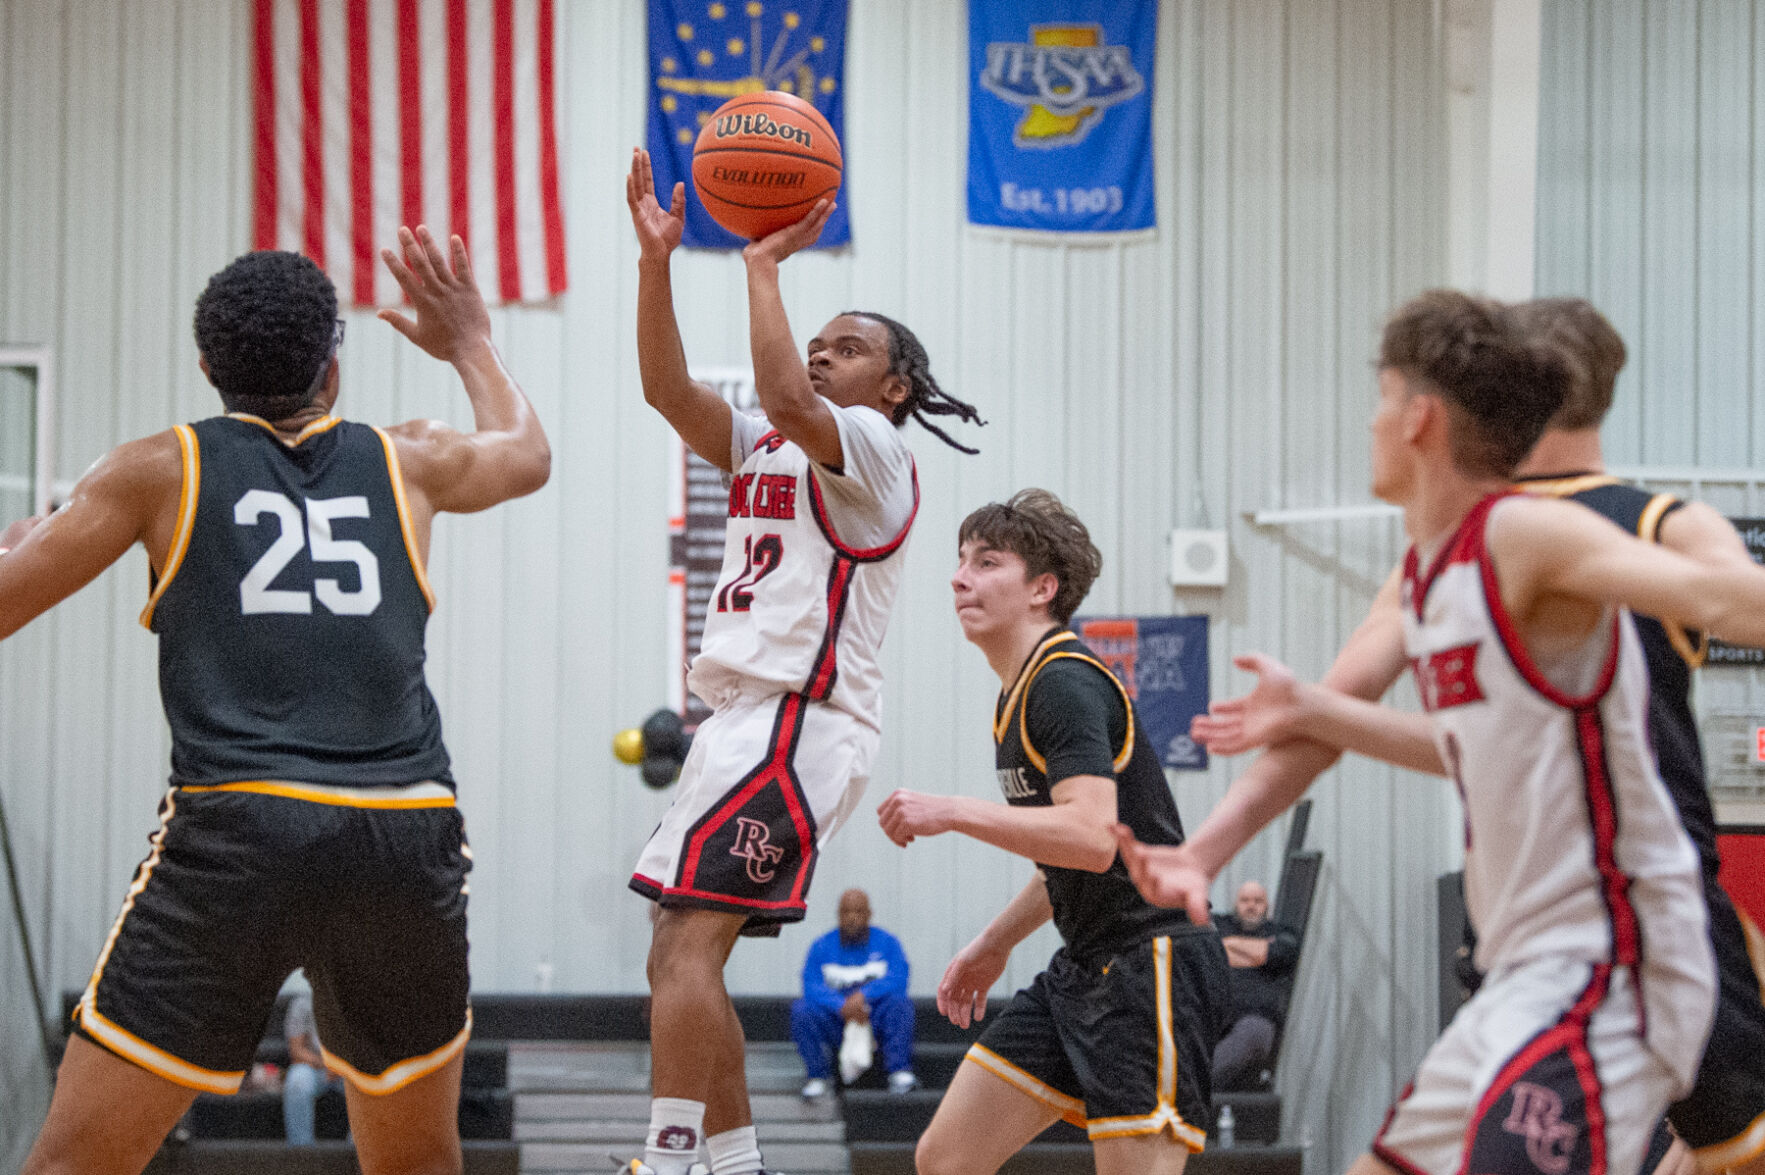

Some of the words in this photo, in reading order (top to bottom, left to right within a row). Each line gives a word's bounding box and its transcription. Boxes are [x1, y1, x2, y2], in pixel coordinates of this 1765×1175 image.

[715, 112, 812, 148] Wilson
[712, 166, 806, 188] EVOLUTION
[233, 488, 382, 616] 25
[717, 533, 784, 612] 12
[729, 816, 785, 883] RC
